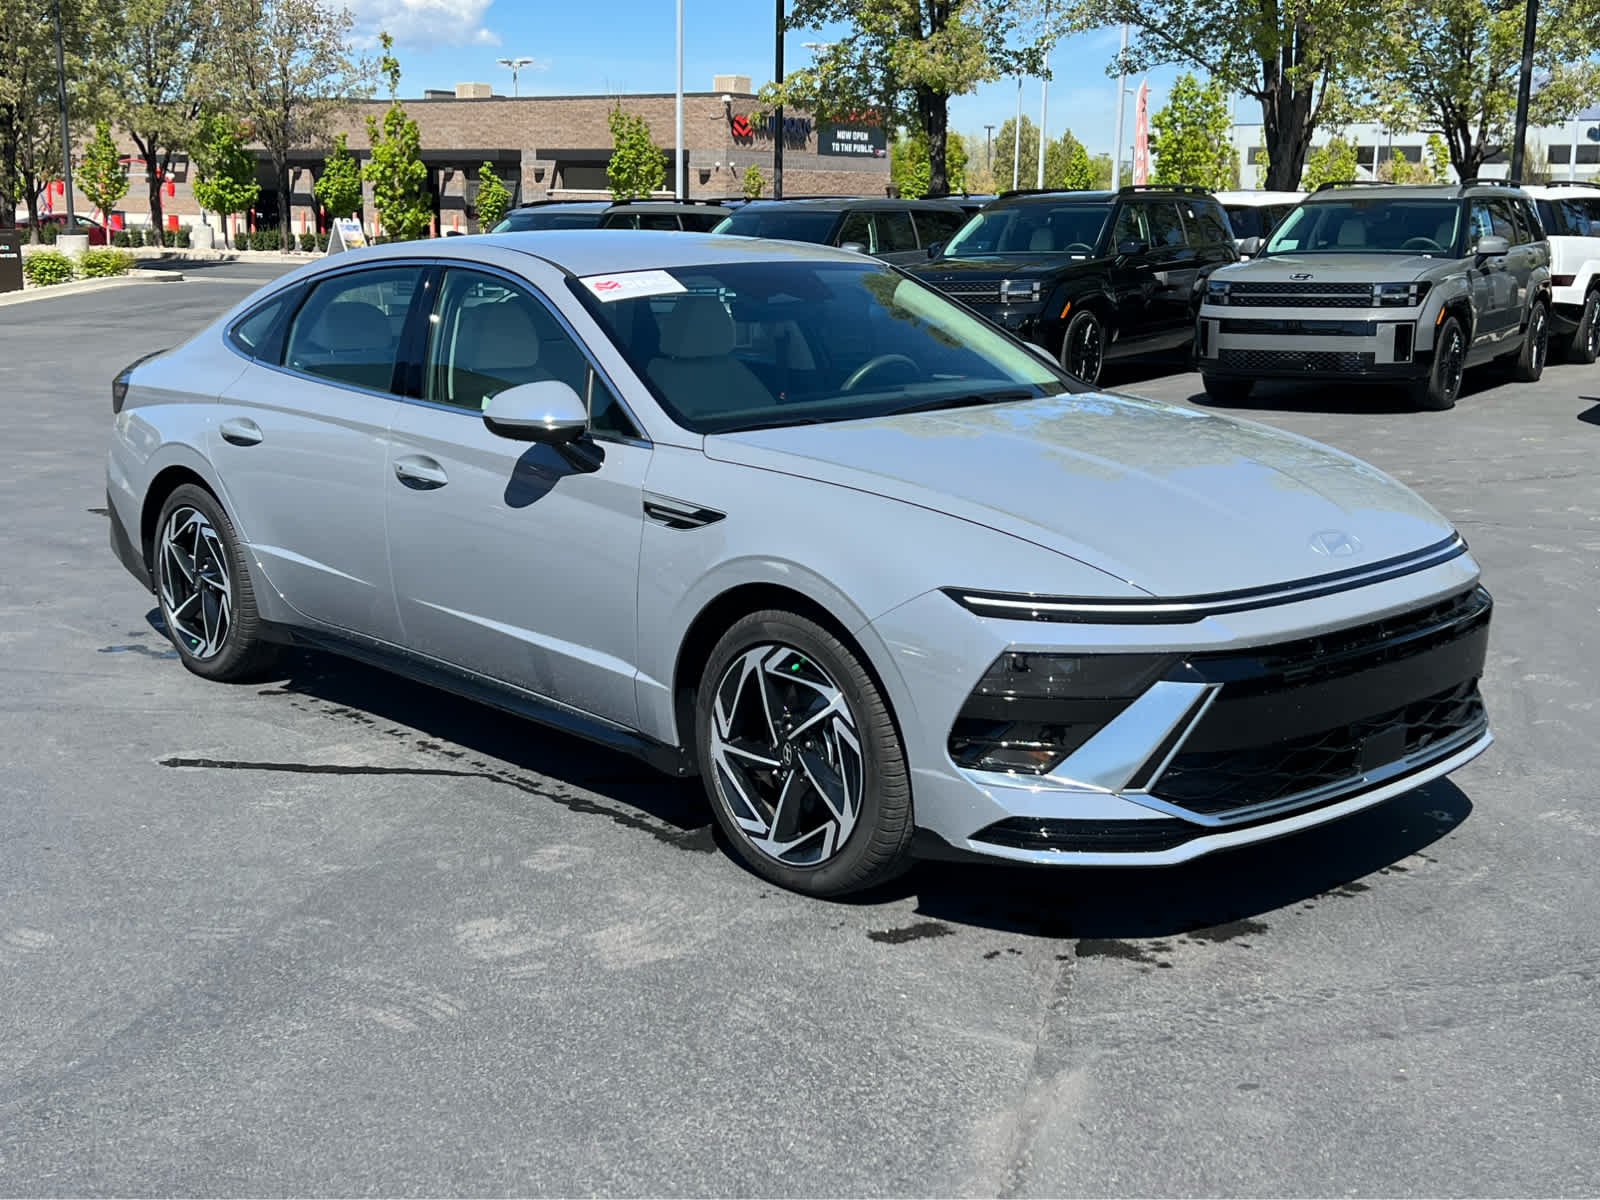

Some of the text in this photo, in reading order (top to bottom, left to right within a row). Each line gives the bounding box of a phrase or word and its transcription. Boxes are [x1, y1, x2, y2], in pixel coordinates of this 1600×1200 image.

[836, 130, 869, 141] NOW OPEN
[832, 142, 874, 153] TO THE PUBLIC
